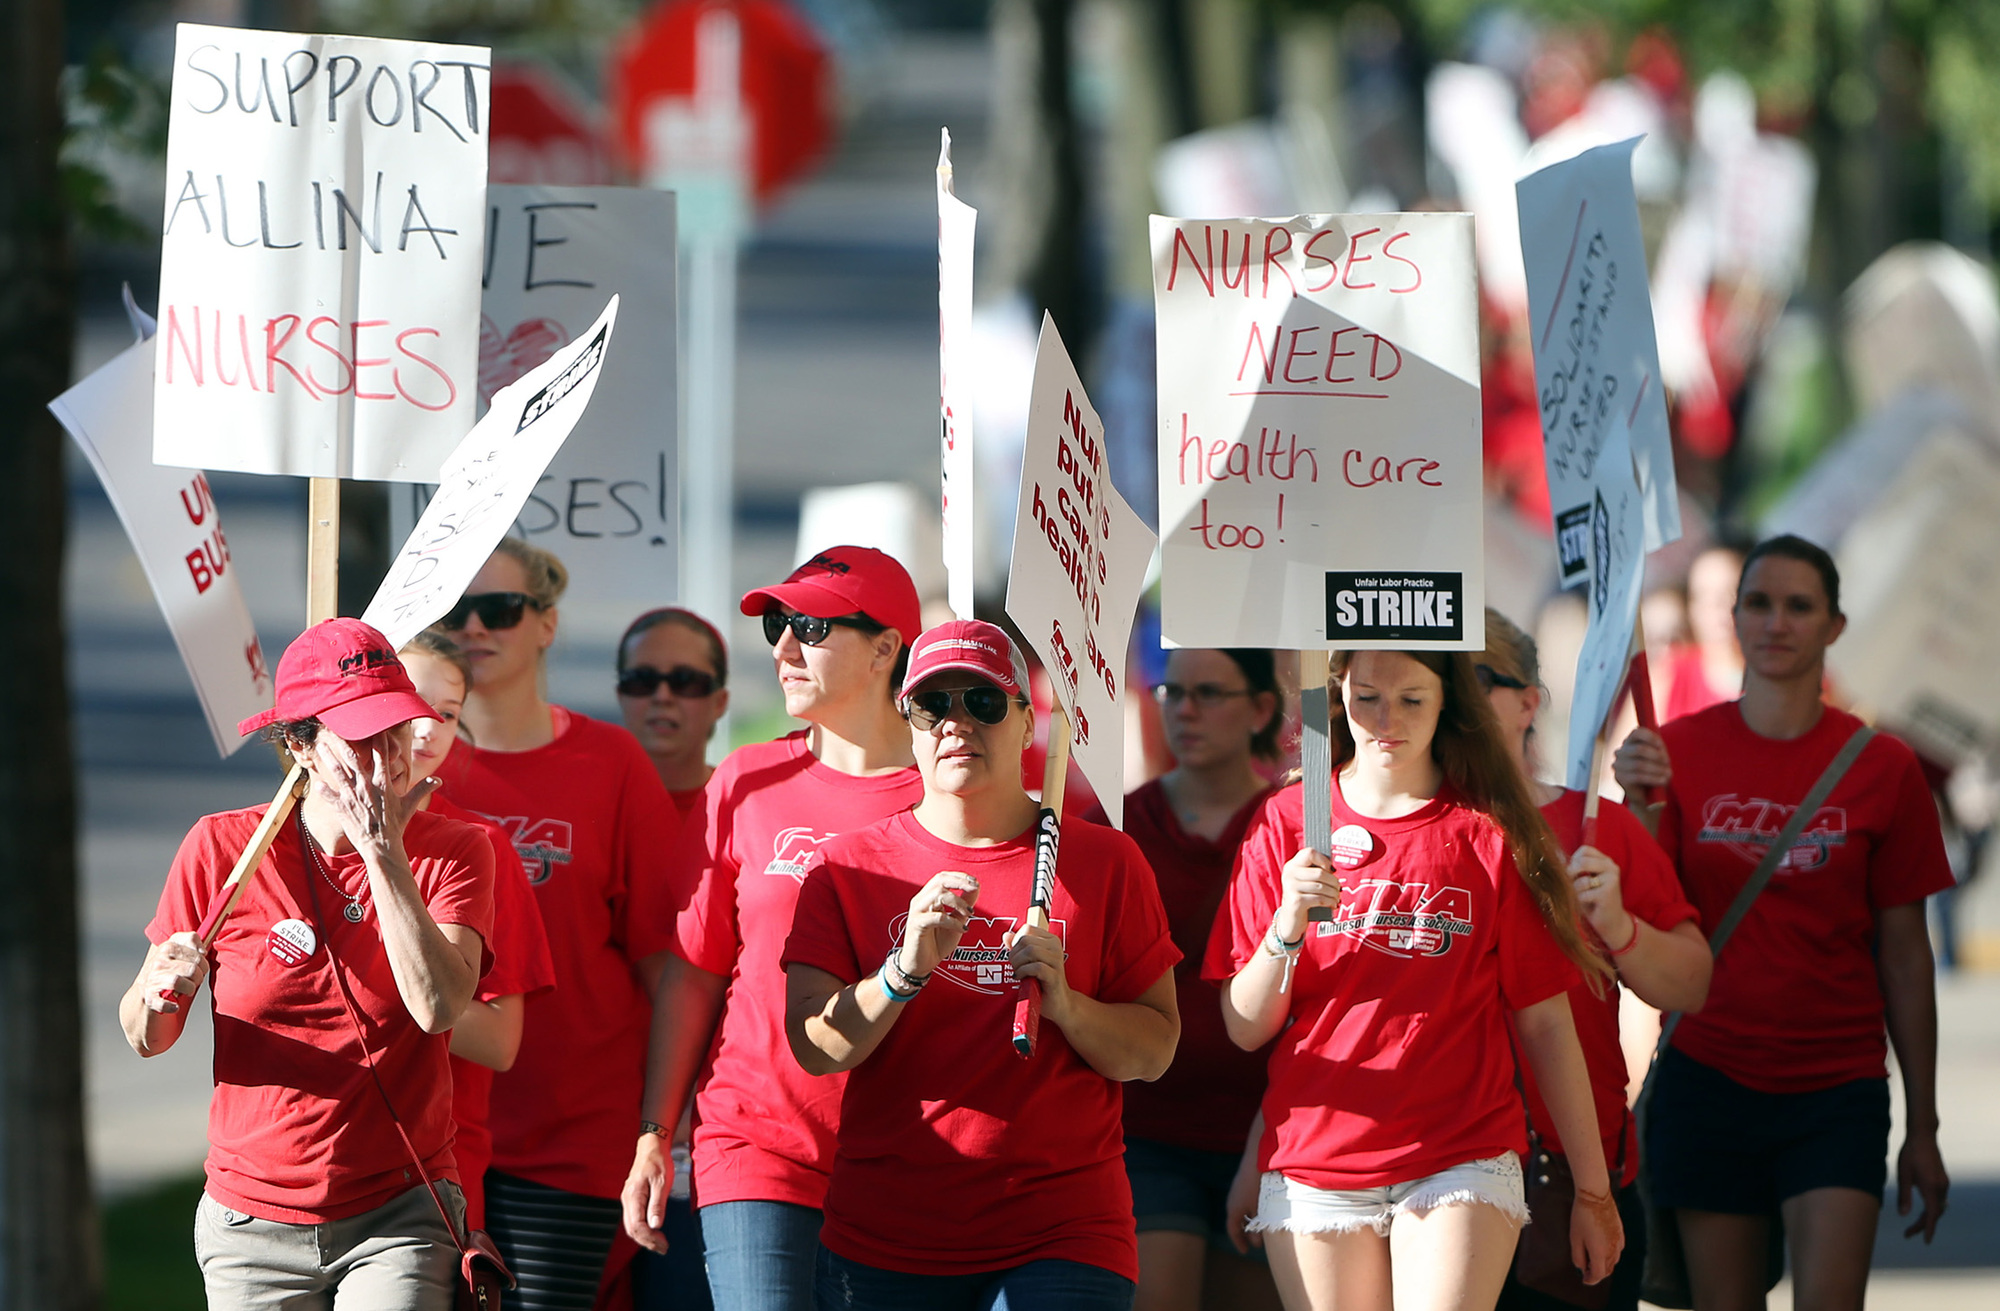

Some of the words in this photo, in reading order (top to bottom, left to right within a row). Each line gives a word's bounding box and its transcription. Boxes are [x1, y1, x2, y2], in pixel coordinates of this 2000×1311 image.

[187, 45, 491, 143] SUPPORT
[164, 170, 459, 260] ALLINA
[482, 203, 597, 290] E
[1167, 226, 1421, 299] NURSES
[166, 305, 456, 411] NURSES
[1237, 321, 1402, 385] NEED
[1542, 227, 1608, 432] SOLIDARITY
[1057, 434, 1093, 517] put
[1178, 413, 1318, 485] health
[1342, 449, 1442, 488] care
[1190, 493, 1285, 550] too!
[1336, 590, 1454, 627] STRIKE
[1354, 578, 1378, 587] Unfair
[1380, 578, 1402, 587] Labor
[1403, 578, 1434, 588] Practice
[1086, 628, 1115, 702] are
[768, 863, 806, 874] Minnes
[292, 924, 306, 938] I'LL
[1318, 917, 1370, 936] Minnesot
[1407, 914, 1474, 935] Association
[1333, 883, 1471, 922] MNA
[280, 927, 310, 950] STRIKE
[952, 949, 996, 962] Nurses
